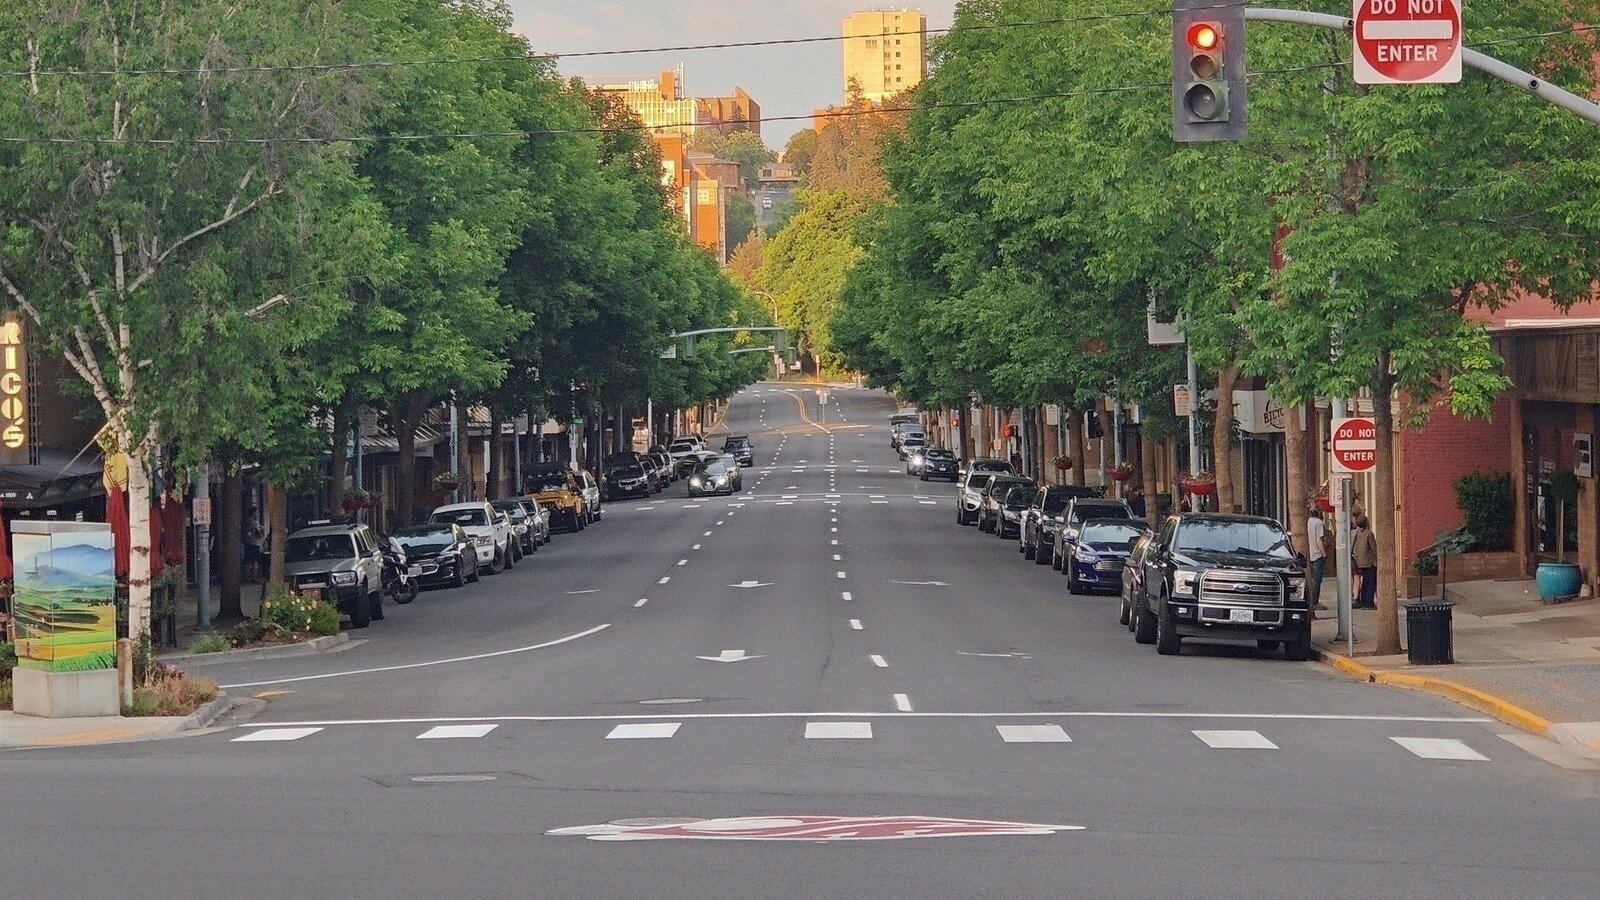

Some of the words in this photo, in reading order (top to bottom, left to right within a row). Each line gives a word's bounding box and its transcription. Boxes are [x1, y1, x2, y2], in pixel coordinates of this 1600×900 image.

[1371, 0, 1397, 15] DO
[1408, 0, 1443, 14] NOT
[1377, 45, 1437, 62] ENTER
[1340, 429, 1353, 438] DO
[1359, 428, 1376, 438] NOT
[1343, 452, 1374, 461] ENTER
